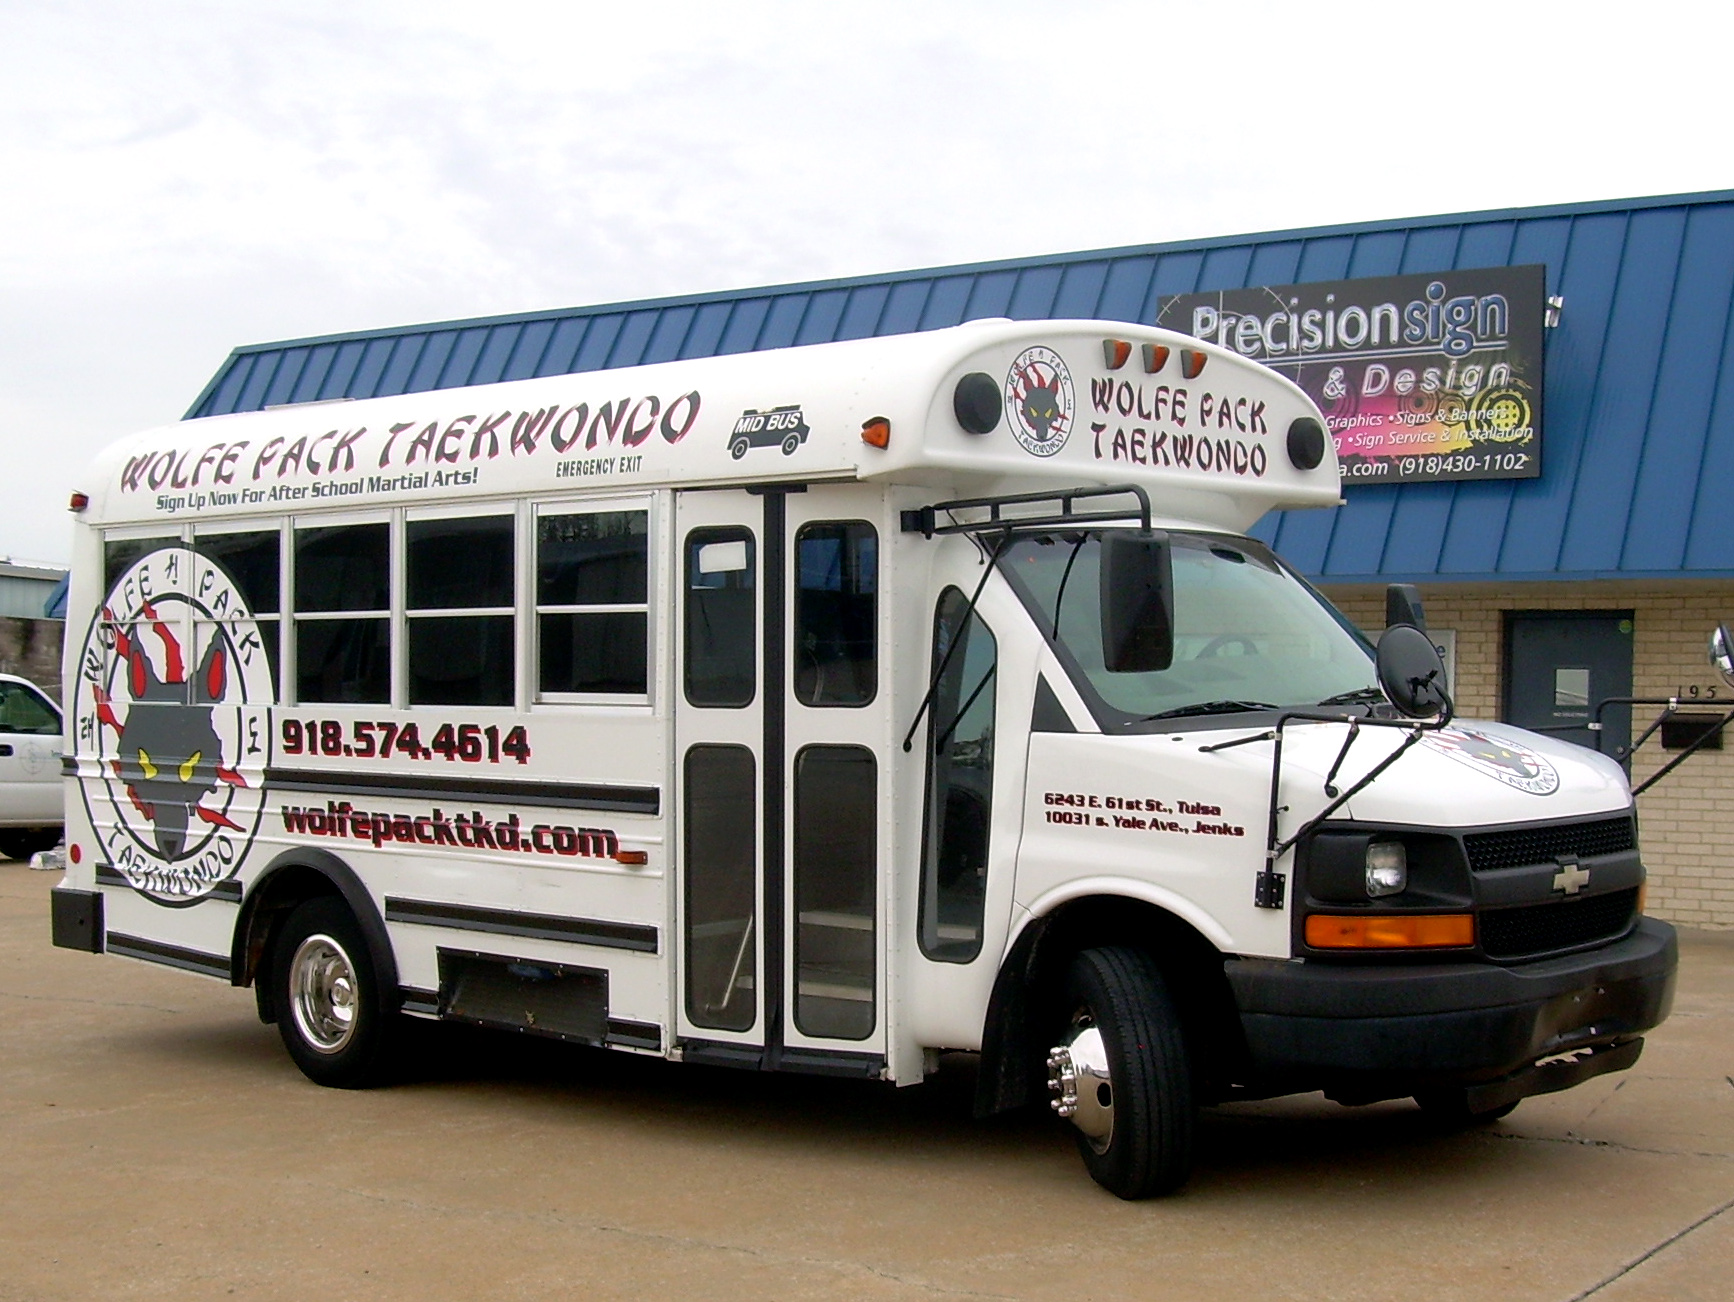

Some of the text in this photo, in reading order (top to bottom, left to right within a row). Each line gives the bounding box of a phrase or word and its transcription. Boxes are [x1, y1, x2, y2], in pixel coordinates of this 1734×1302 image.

[1323, 359, 1511, 399] & Design
[735, 412, 801, 435] MID BUS
[1091, 377, 1268, 436] WOLFE PACK
[1325, 408, 1506, 431] Graphics Signs & Banners
[120, 390, 701, 494] WOLFE PACK TAEKWONDO
[1090, 421, 1268, 478] TAEKWONDO
[1354, 433, 1387, 449] Sign
[1388, 430, 1436, 445] Service
[1440, 430, 1451, 442] &
[1455, 426, 1533, 441] Installation
[555, 455, 643, 478] EMERGENCY EXIT
[1399, 454, 1526, 477] (918)430-1102
[156, 467, 479, 513] Sign Up Now For After School Martial Arts!
[84, 564, 261, 682] WOLFE PACK
[281, 719, 531, 765] 918.574.4614
[1044, 792, 1085, 808] 6243
[1088, 795, 1102, 809] E.
[1105, 797, 1143, 811] 61st
[1176, 800, 1222, 817] Tulsa
[1045, 811, 1245, 837] 10031 s. Yale Ave., Jenks
[281, 801, 620, 860] wolfepacktkd.com
[108, 821, 234, 896] TAEKWONDO
